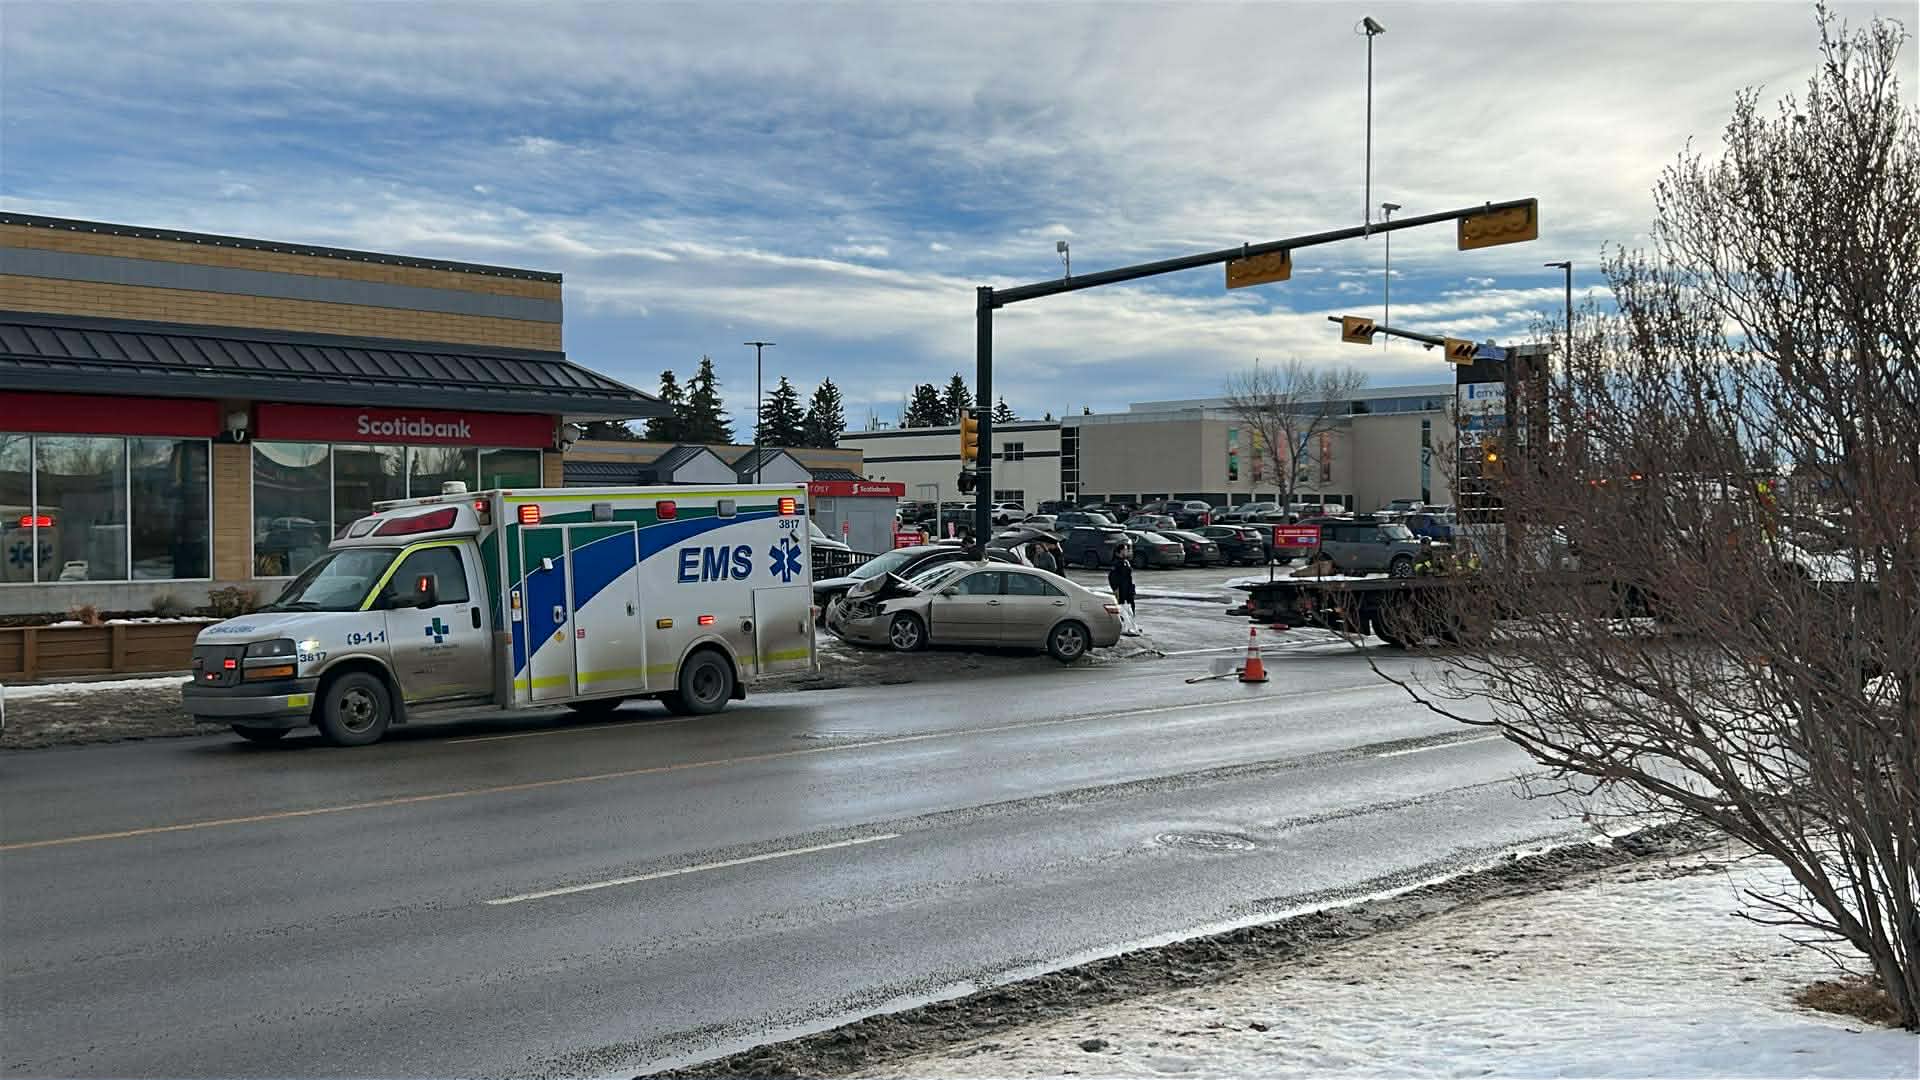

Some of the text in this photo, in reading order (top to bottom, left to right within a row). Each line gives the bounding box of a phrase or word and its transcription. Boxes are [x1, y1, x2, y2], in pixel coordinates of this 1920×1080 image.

[358, 415, 471, 438] Scotiabank
[778, 519, 800, 529] 3817
[678, 545, 752, 583] EMS
[299, 652, 327, 662] 3817
